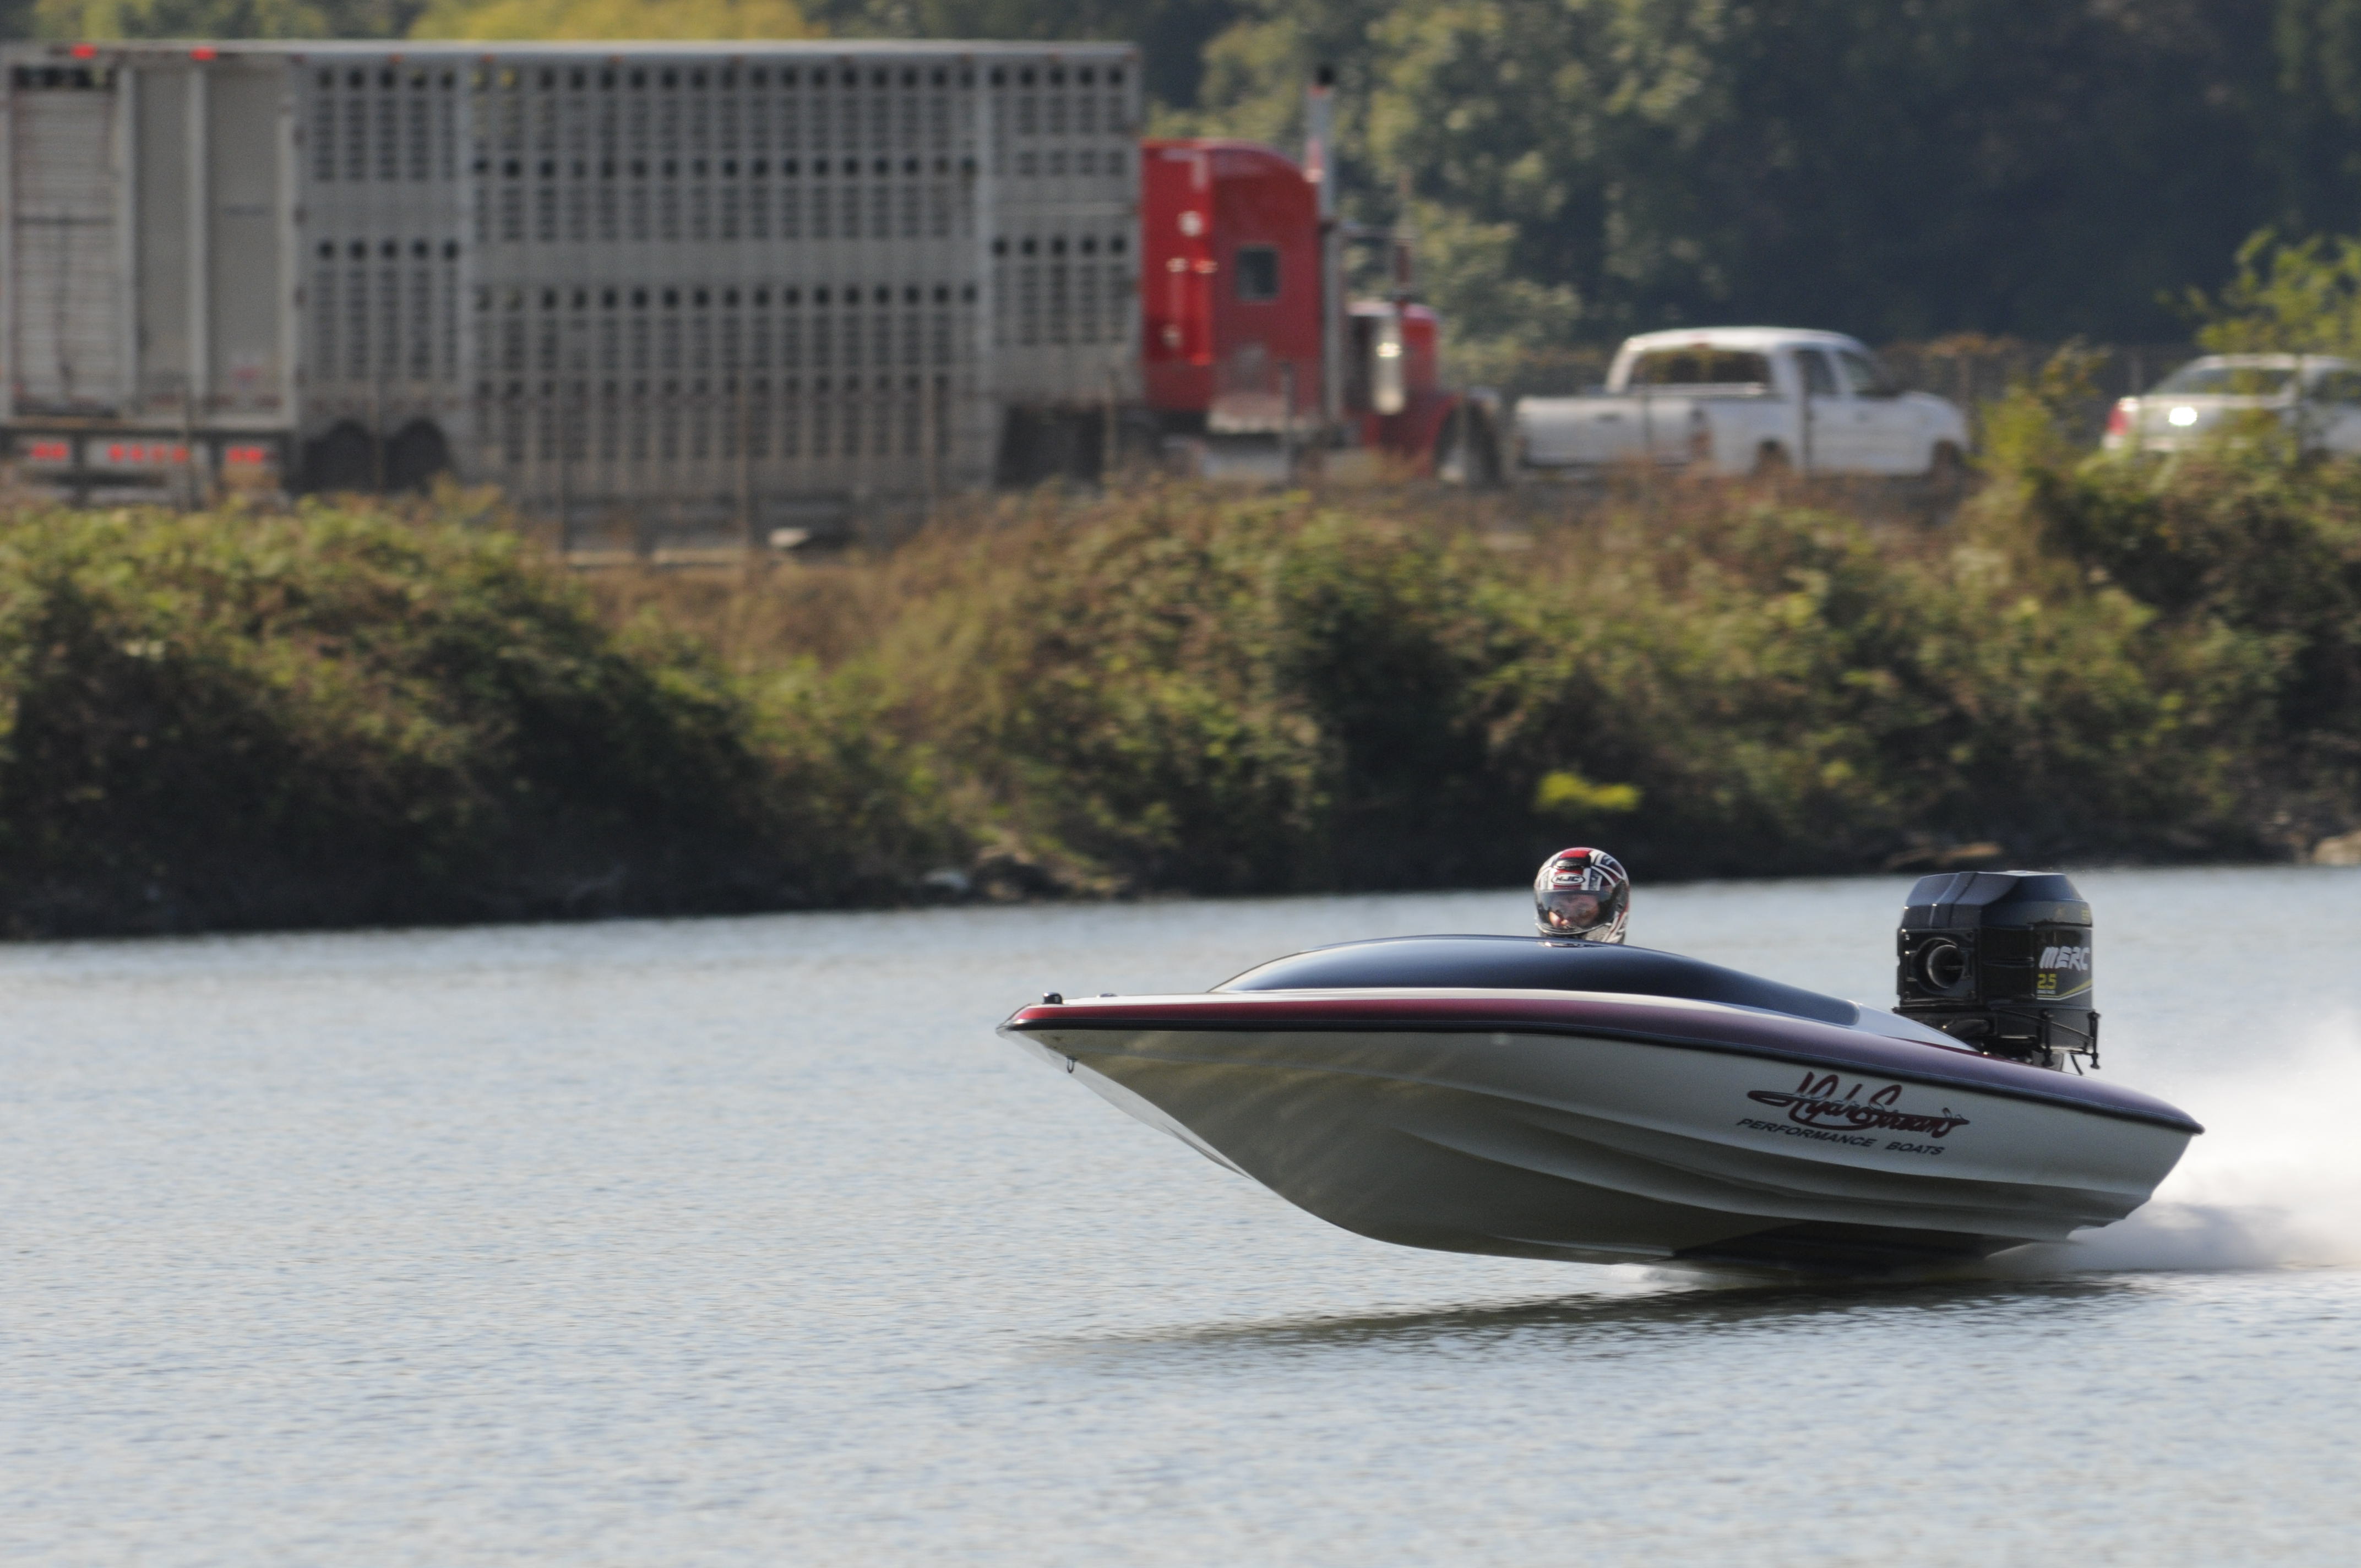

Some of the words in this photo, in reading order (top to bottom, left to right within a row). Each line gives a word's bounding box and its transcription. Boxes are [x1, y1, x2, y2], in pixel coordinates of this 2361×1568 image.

[2039, 946, 2090, 971] MERC
[1737, 1118, 1877, 1147] PERFORMANCE
[1885, 1142, 1945, 1155] BOATS
